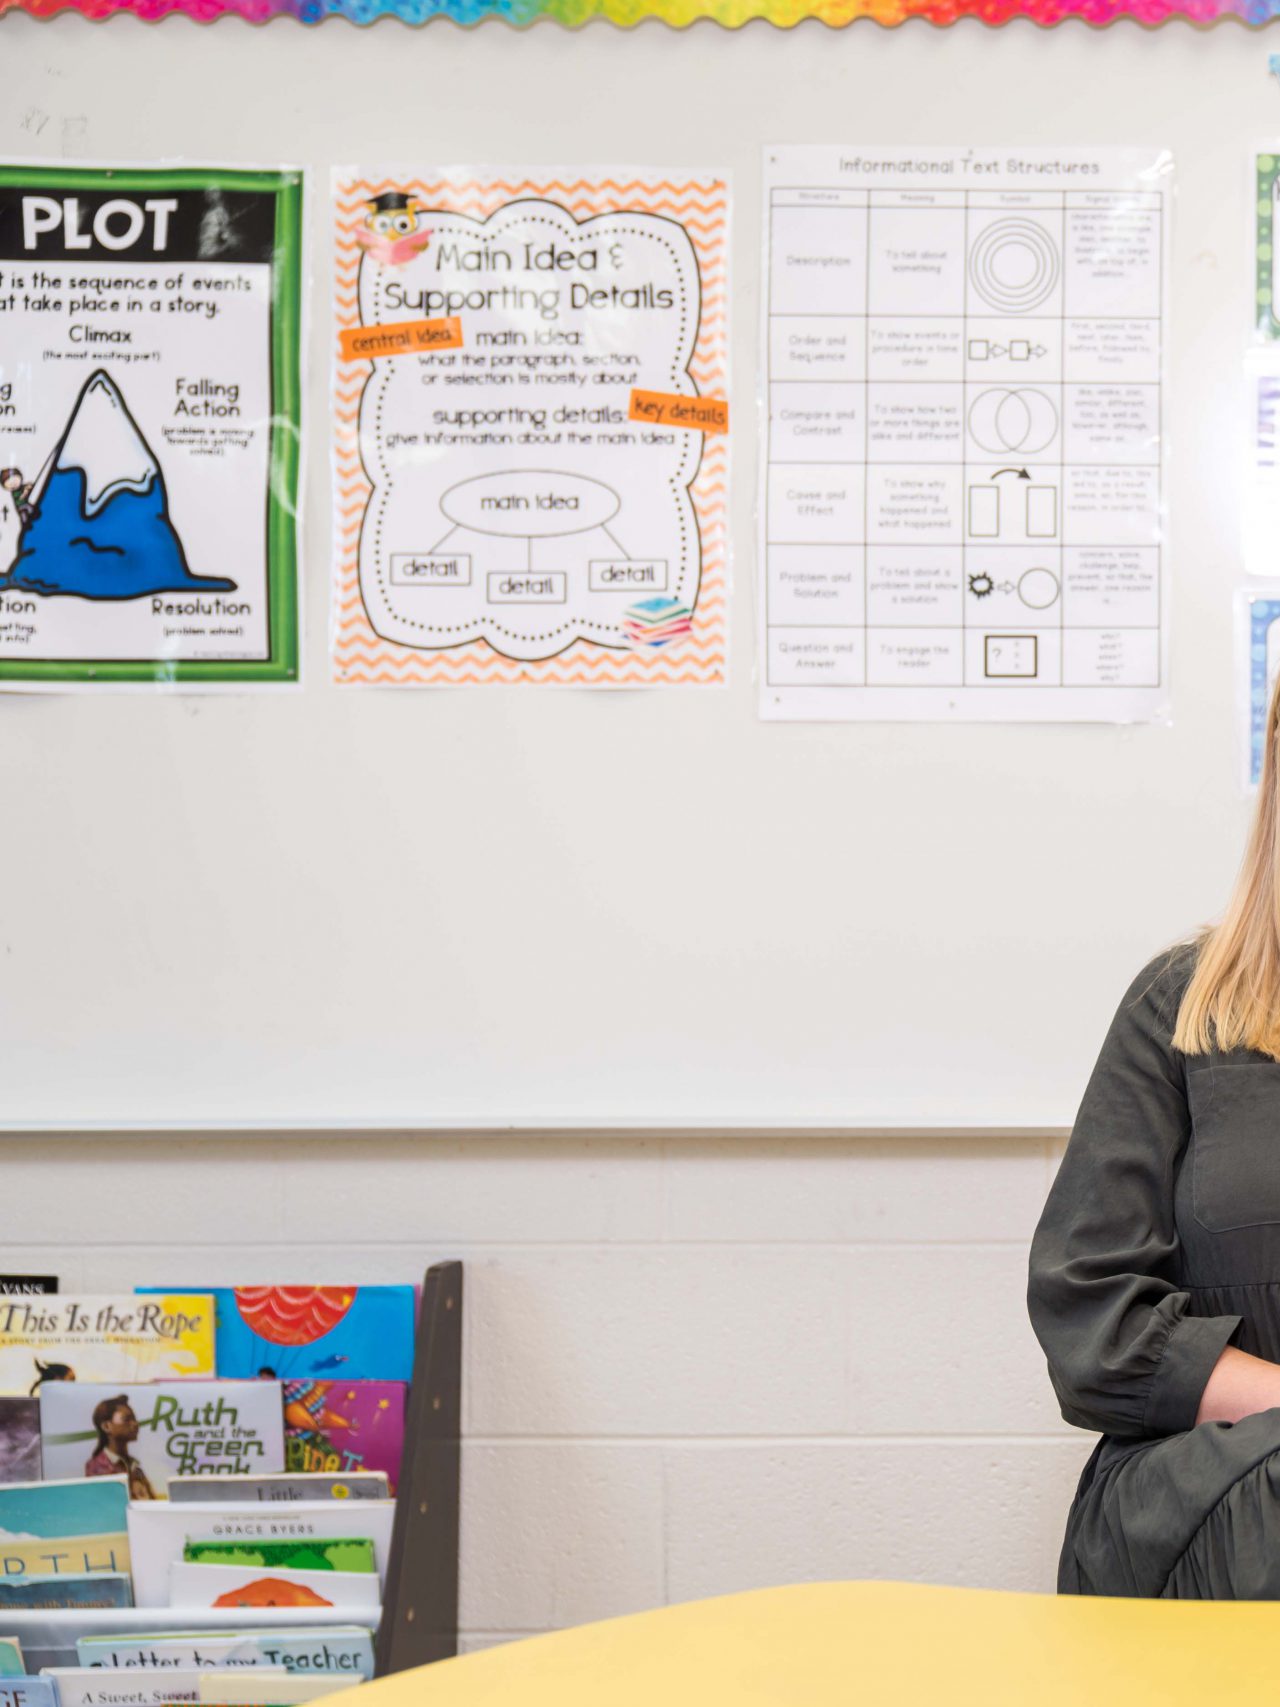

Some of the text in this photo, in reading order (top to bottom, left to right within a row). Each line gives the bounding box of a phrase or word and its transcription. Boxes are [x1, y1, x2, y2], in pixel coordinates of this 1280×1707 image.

[839, 158, 1099, 174] Informational Text Structures
[22, 196, 178, 251] PLOT
[436, 244, 511, 272] Main
[523, 244, 598, 271] Idea
[12, 271, 252, 295] is the sequence of events
[24, 294, 62, 310] take
[69, 293, 120, 315] place
[127, 297, 143, 312] in
[150, 300, 161, 312] a
[168, 298, 220, 319] story.
[385, 283, 674, 320] Supporting Details
[69, 325, 132, 344] Climax
[352, 329, 452, 352] central idea
[476, 330, 583, 345] main idea:
[418, 353, 640, 369] what the paragraph, section,
[422, 372, 638, 387] or selection is mostly about
[175, 378, 240, 402] Falling
[174, 401, 240, 418] Action
[433, 406, 628, 429] supporting details:
[634, 399, 725, 425] key details
[386, 432, 674, 448] give information about the main idea
[481, 494, 579, 511] main idea
[403, 560, 459, 578] detail
[601, 566, 655, 582] detail
[500, 579, 554, 595] detail
[152, 598, 251, 616] Resolution
[0, 1303, 201, 1339] This Is the Rope
[139, 1395, 238, 1432] Ruth
[194, 1428, 256, 1438] and the
[166, 1432, 264, 1459] Green
[213, 1524, 315, 1535] GRACE BYERS
[264, 1646, 362, 1671] Teacher
[82, 1690, 197, 1704] A Sweet, Sweet
